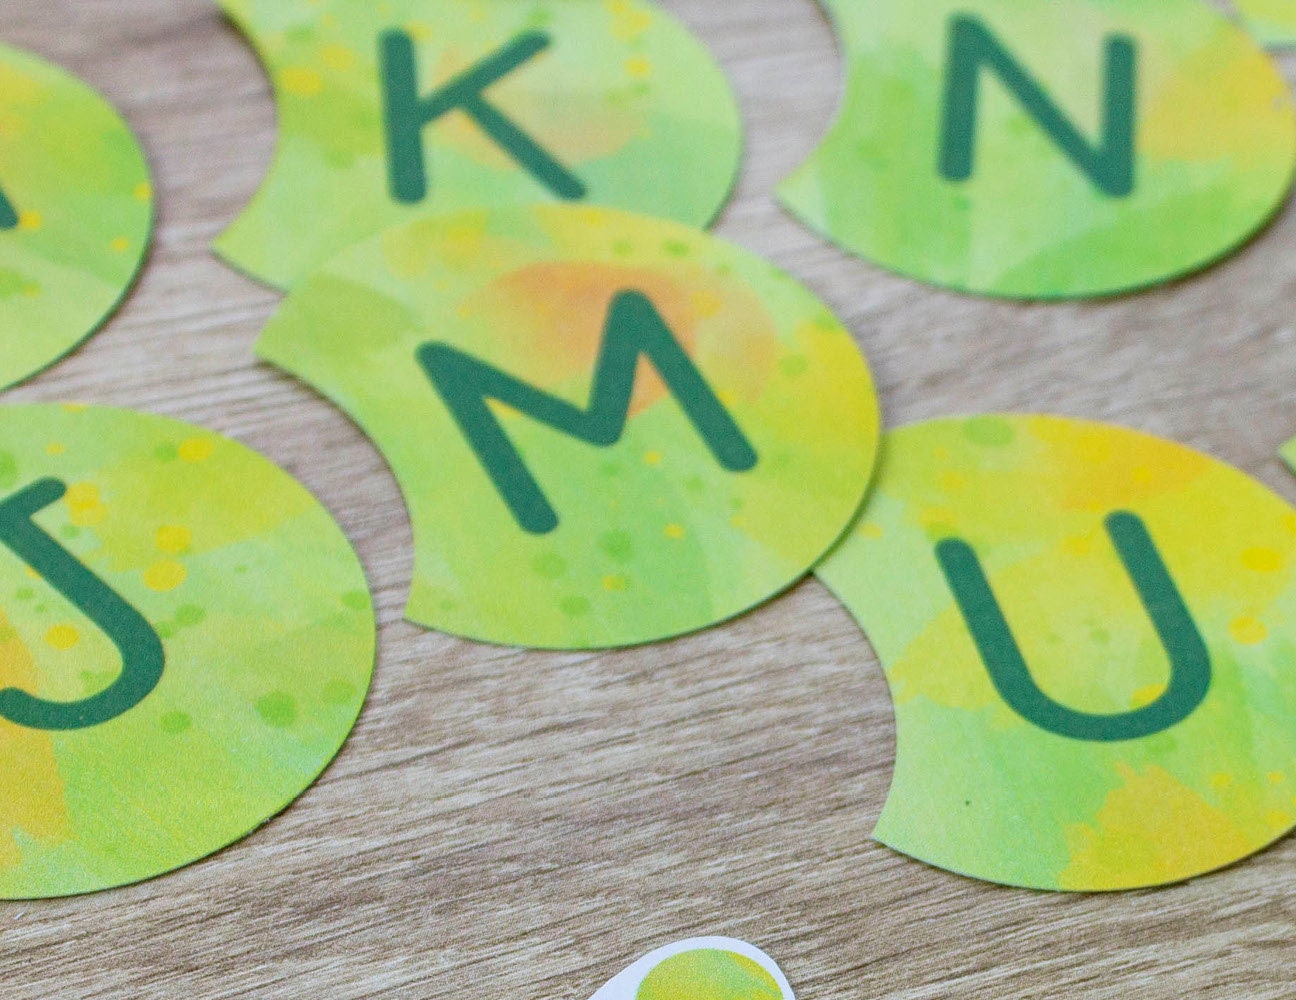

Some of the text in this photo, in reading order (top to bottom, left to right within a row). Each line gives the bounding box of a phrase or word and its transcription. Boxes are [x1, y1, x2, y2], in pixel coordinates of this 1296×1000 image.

[379, 29, 588, 206] K
[936, 13, 1138, 200] N
[416, 288, 760, 536] M
[0, 476, 167, 732] J
[934, 510, 1214, 744] U
